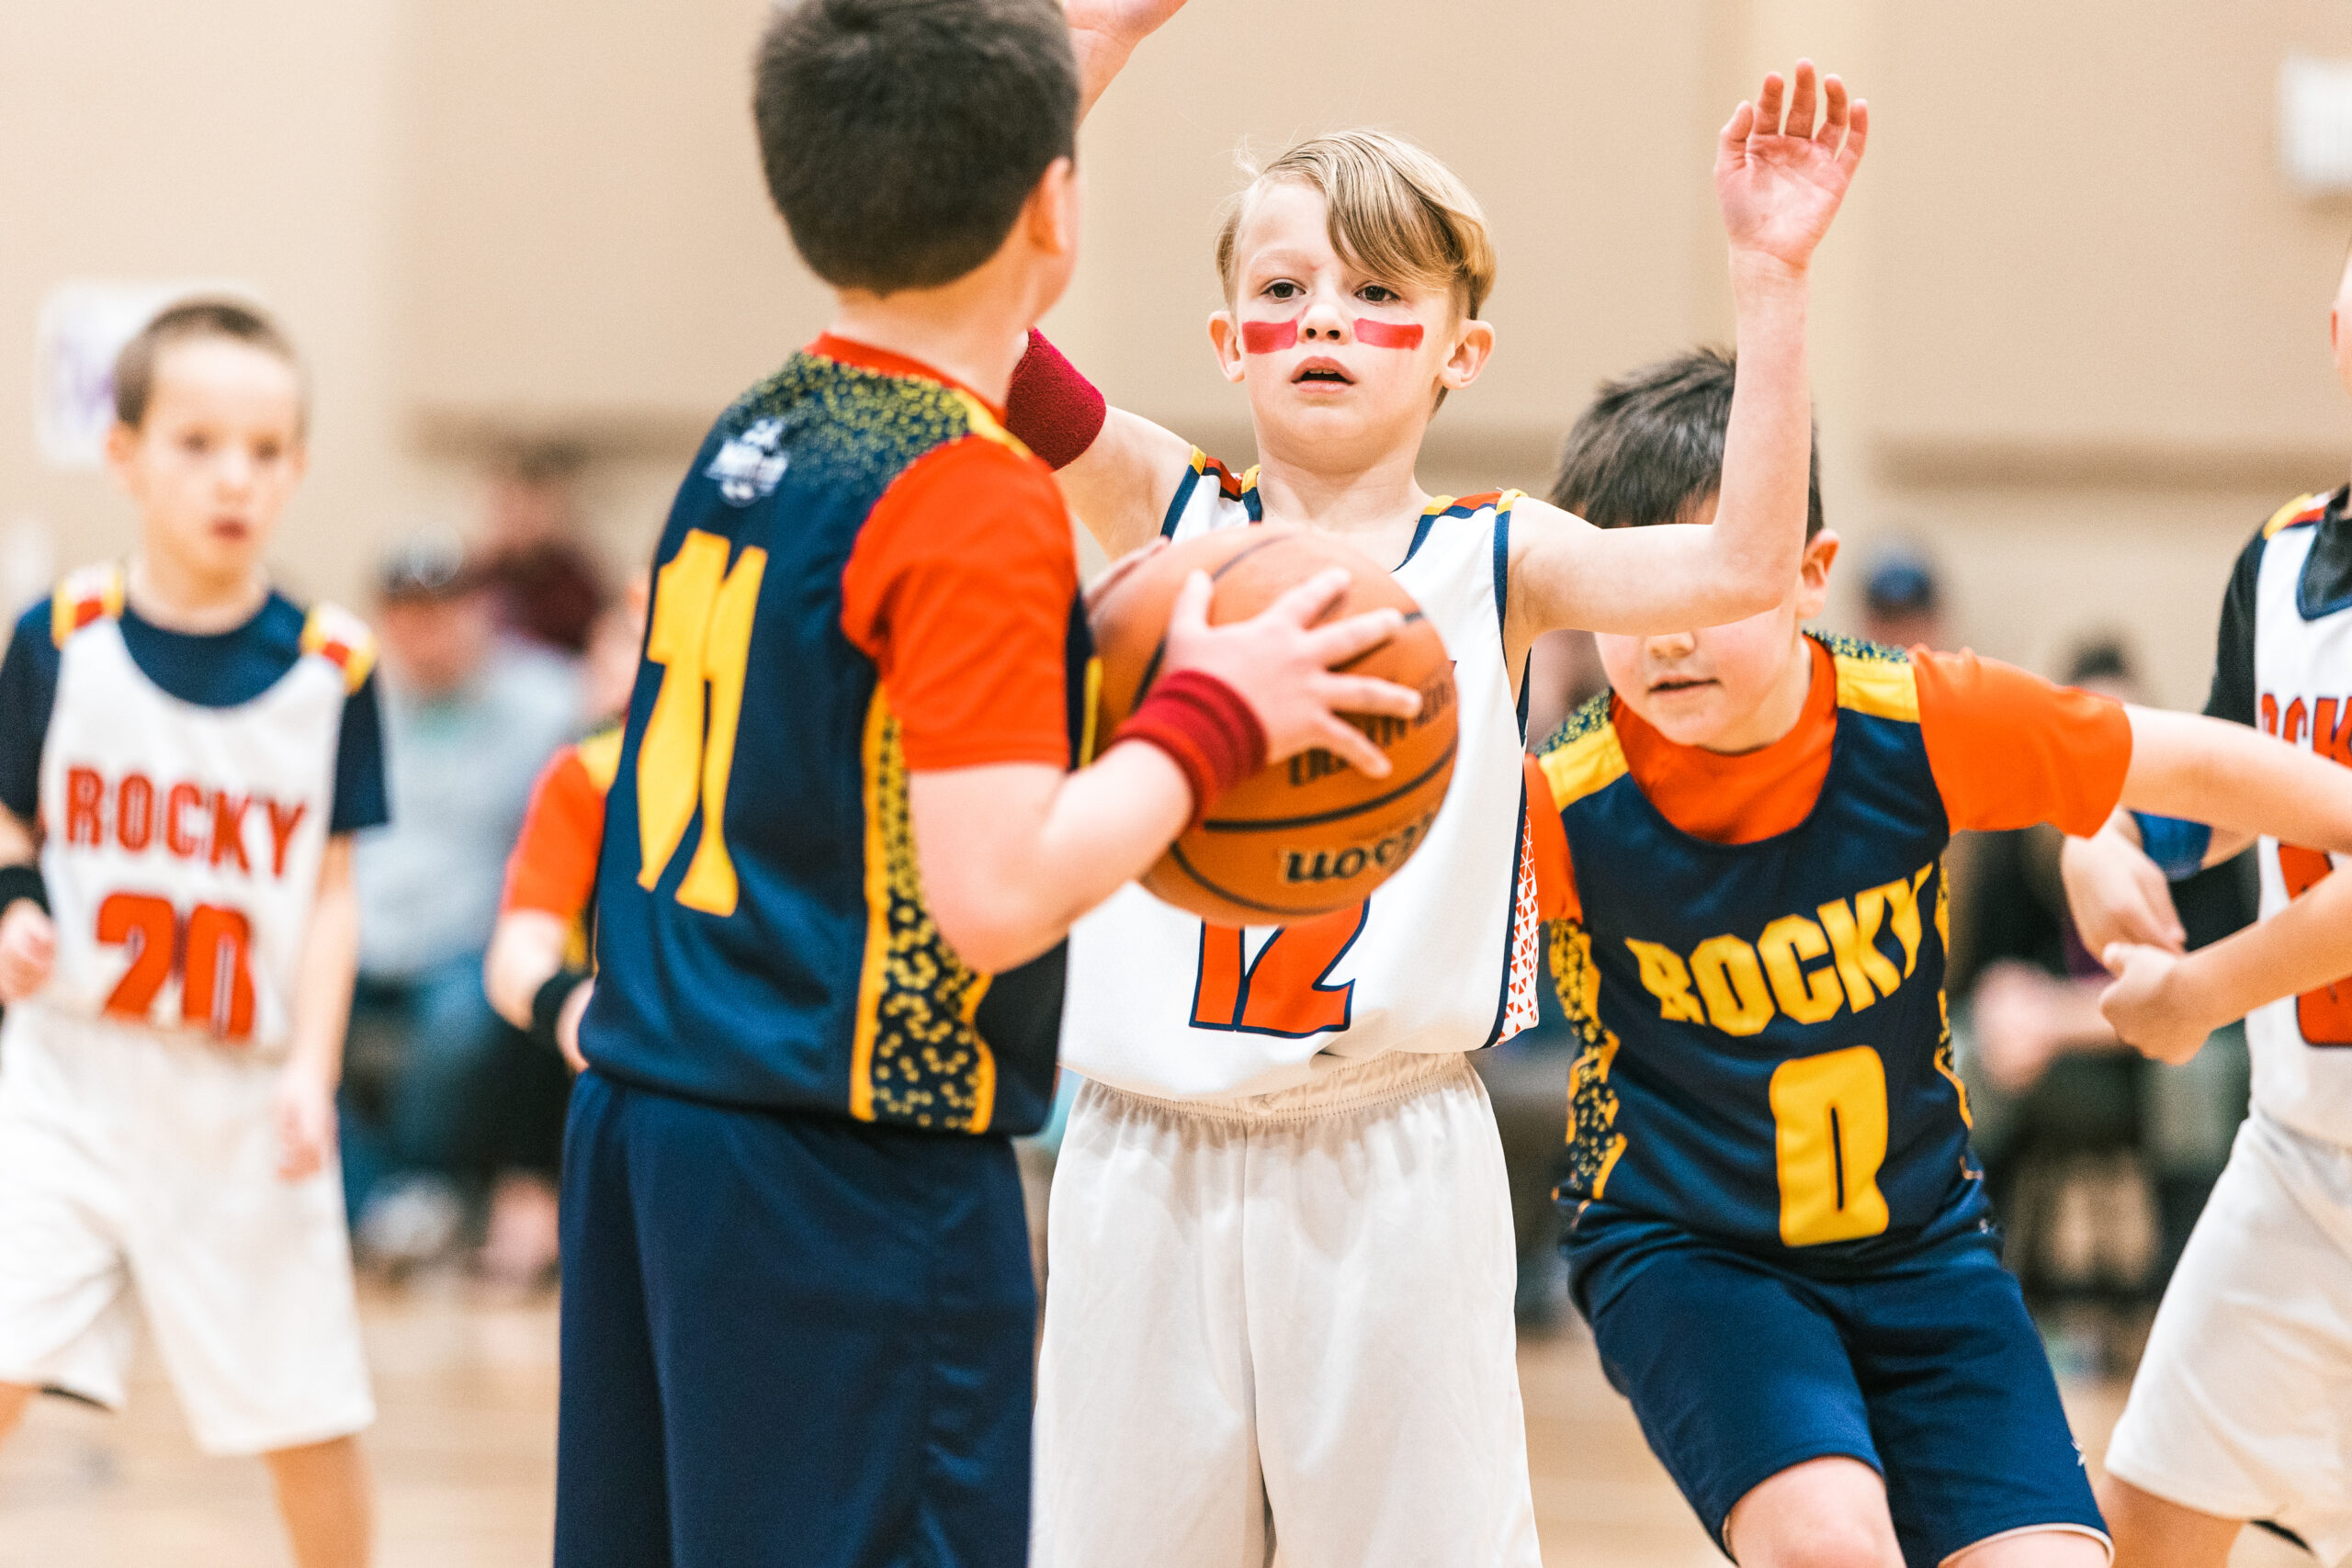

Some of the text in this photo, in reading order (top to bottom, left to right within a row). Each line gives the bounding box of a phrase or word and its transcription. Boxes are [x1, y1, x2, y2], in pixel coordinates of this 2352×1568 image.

[66, 766, 307, 877] ROCKY
[96, 891, 255, 1043] 20
[1189, 895, 1371, 1039] 12
[1624, 862, 1934, 1036] ROCKY
